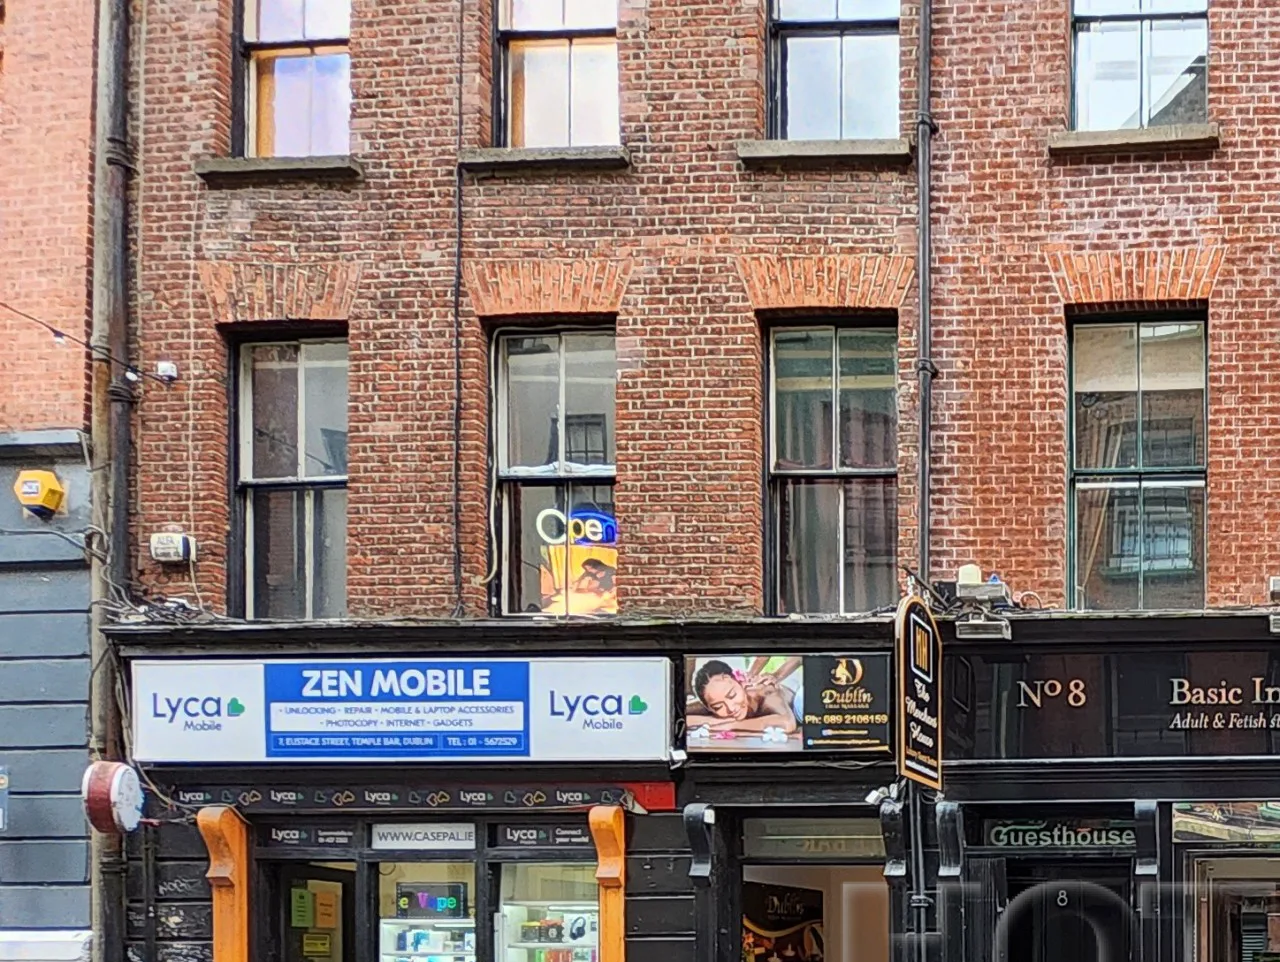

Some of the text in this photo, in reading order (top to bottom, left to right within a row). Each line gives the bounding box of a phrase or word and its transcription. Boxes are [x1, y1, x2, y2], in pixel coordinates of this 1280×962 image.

[536, 508, 617, 544] Open
[302, 669, 491, 697] ZEN MOBILE
[822, 687, 874, 704] Dublin
[1169, 678, 1243, 705] Basic
[152, 693, 222, 723] Lyca
[423, 706, 456, 714] LAPTOP
[457, 706, 515, 714] ACCESSORIES
[549, 690, 623, 721] Lyca
[183, 721, 222, 731] Mobile
[326, 719, 473, 727] PHOTOCOPY INTERNET GADGETS
[583, 719, 623, 729] Mobile
[1169, 712, 1210, 729] Adult
[1212, 713, 1226, 729] &
[1228, 712, 1267, 729] Fetish
[179, 791, 204, 801] Lyca
[270, 790, 296, 801] Lyca
[365, 790, 390, 801] Lyca
[460, 790, 486, 802] Lyca
[556, 790, 582, 802] Lyca
[272, 828, 299, 841] Lyca
[378, 831, 474, 842] WWW.CASEPAL.IE
[506, 828, 537, 841] Lyca
[990, 825, 1136, 846] Guesthouse
[1057, 890, 1068, 906] 8
